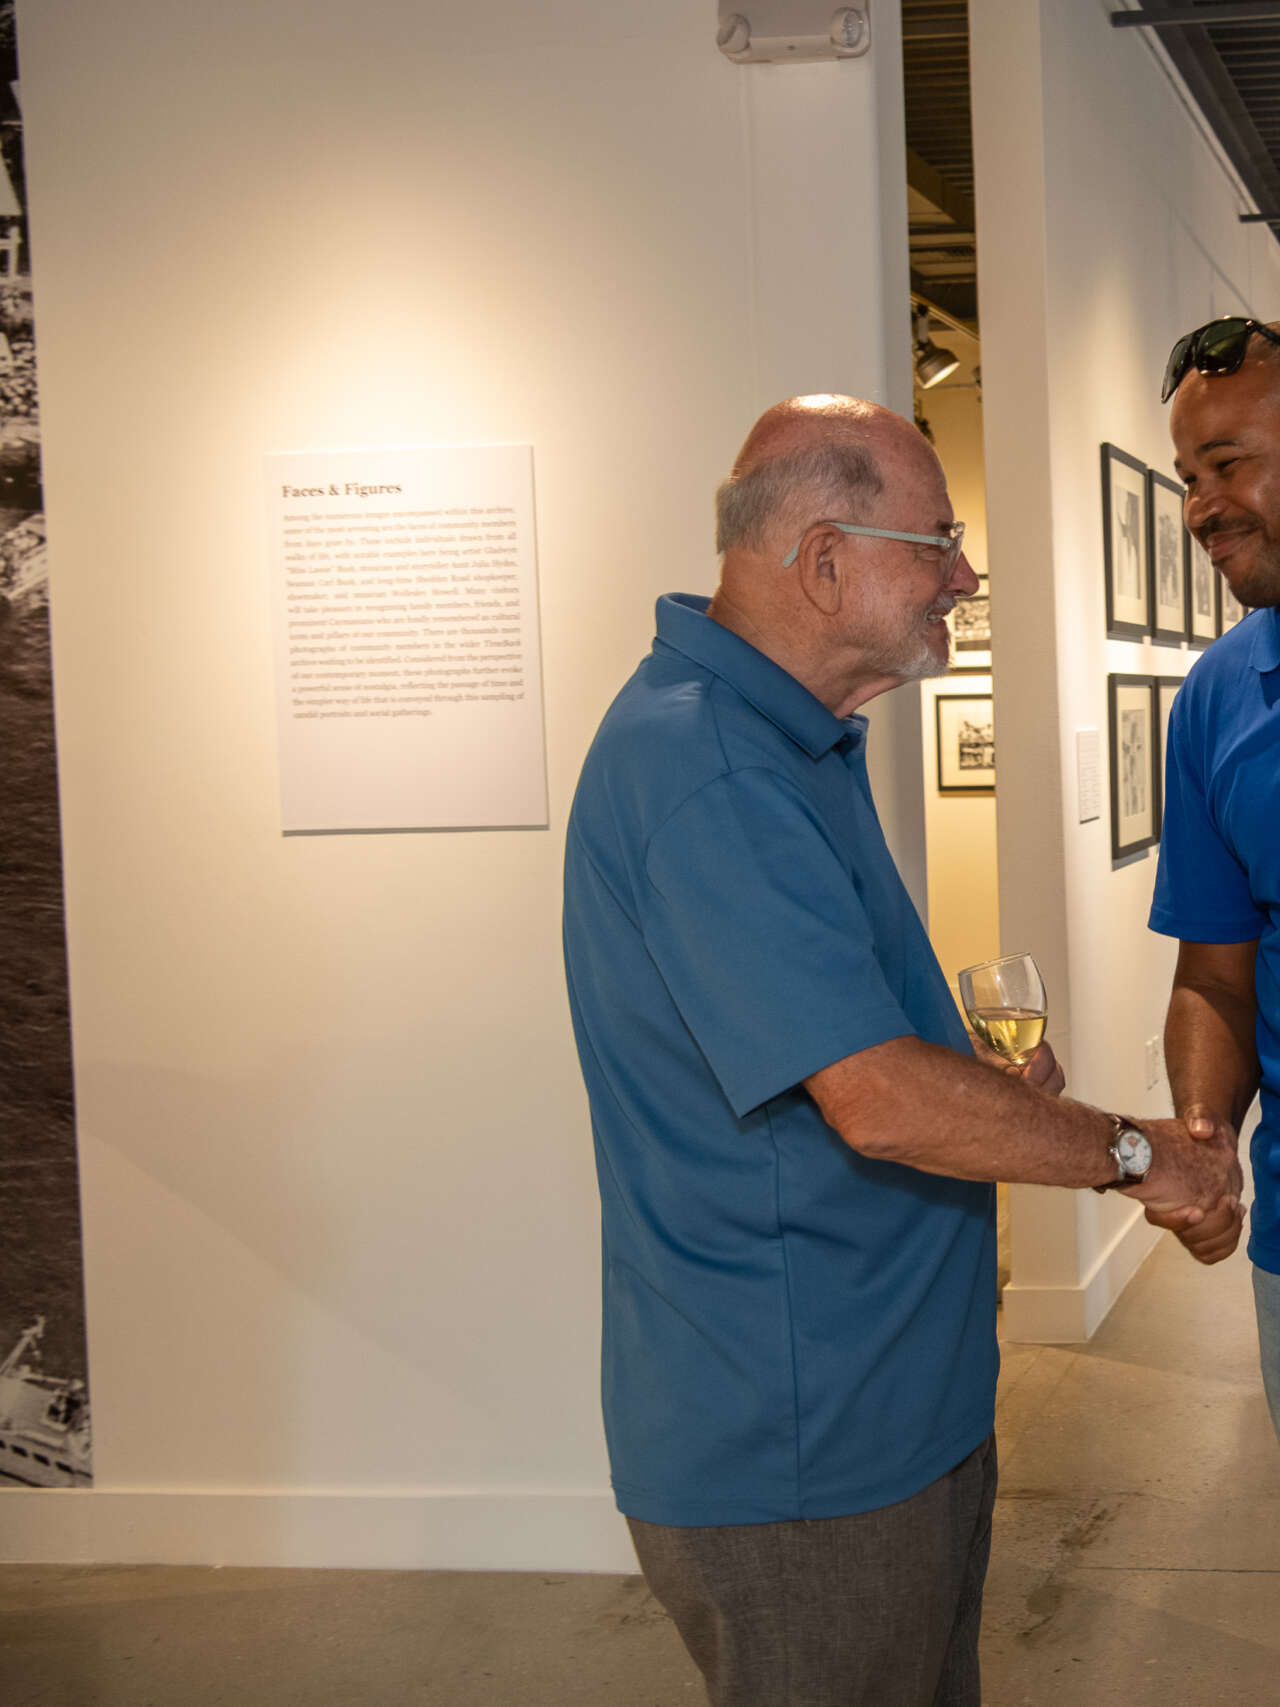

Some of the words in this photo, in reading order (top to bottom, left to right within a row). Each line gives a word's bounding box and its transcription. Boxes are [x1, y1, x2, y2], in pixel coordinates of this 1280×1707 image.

[282, 485, 325, 498] Faces
[328, 484, 339, 496] &
[345, 482, 402, 498] Figures
